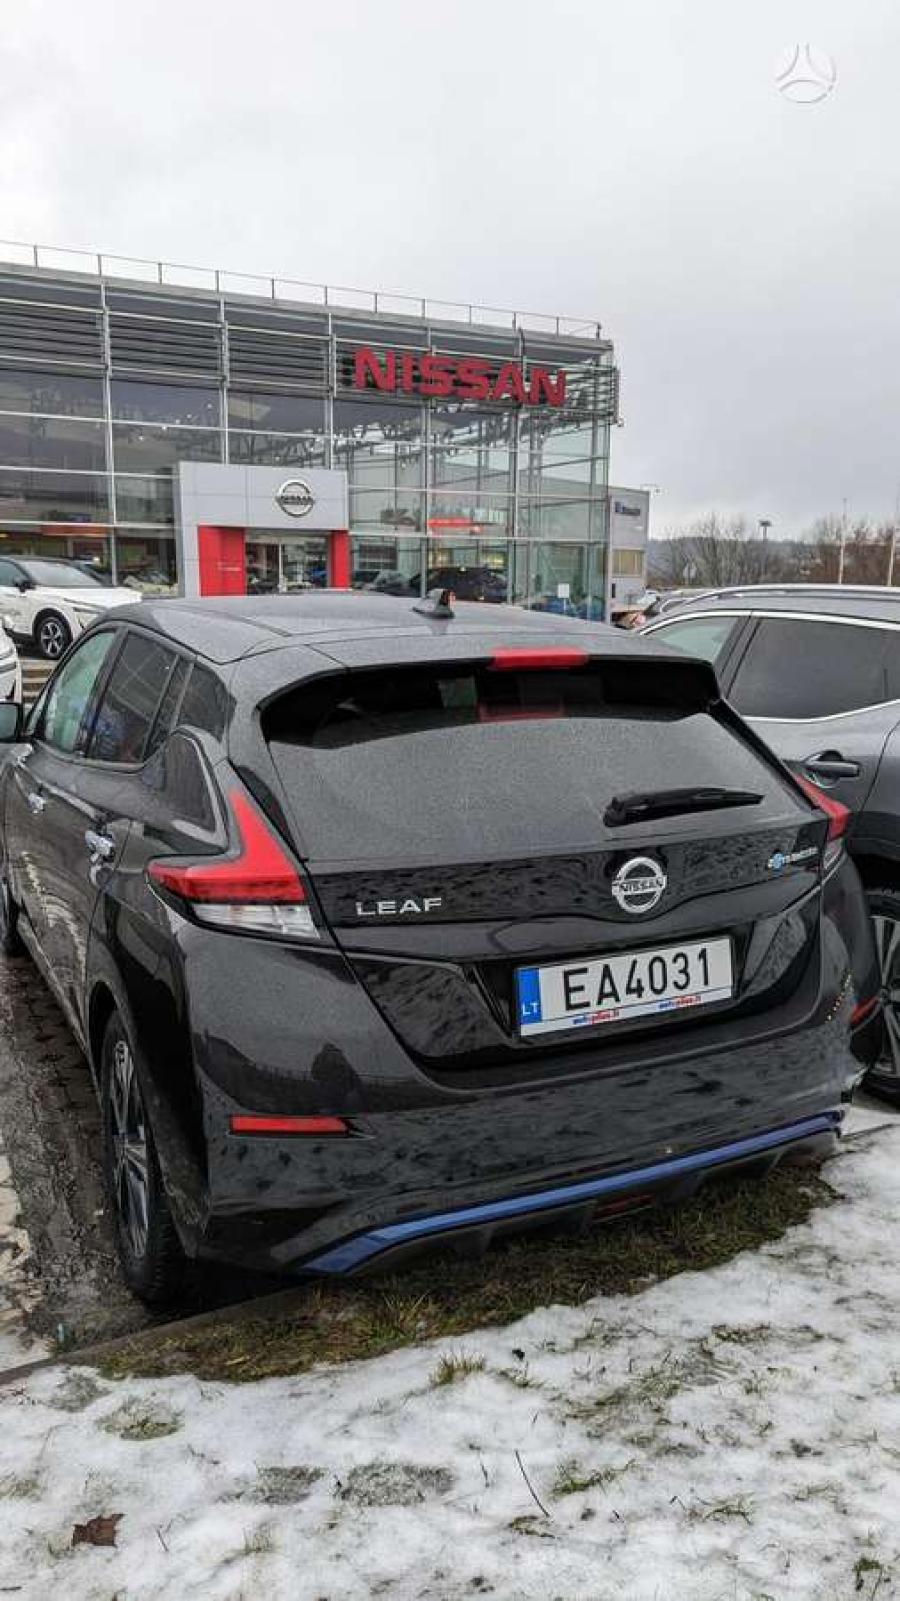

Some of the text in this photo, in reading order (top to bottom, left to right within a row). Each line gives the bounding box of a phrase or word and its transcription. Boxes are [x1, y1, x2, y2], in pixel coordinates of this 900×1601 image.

[354, 346, 566, 406] NISSAN
[621, 877, 663, 893] NISSAN
[355, 898, 442, 916] LEAF
[563, 948, 709, 1011] EA4031
[521, 1002, 538, 1015] LT
